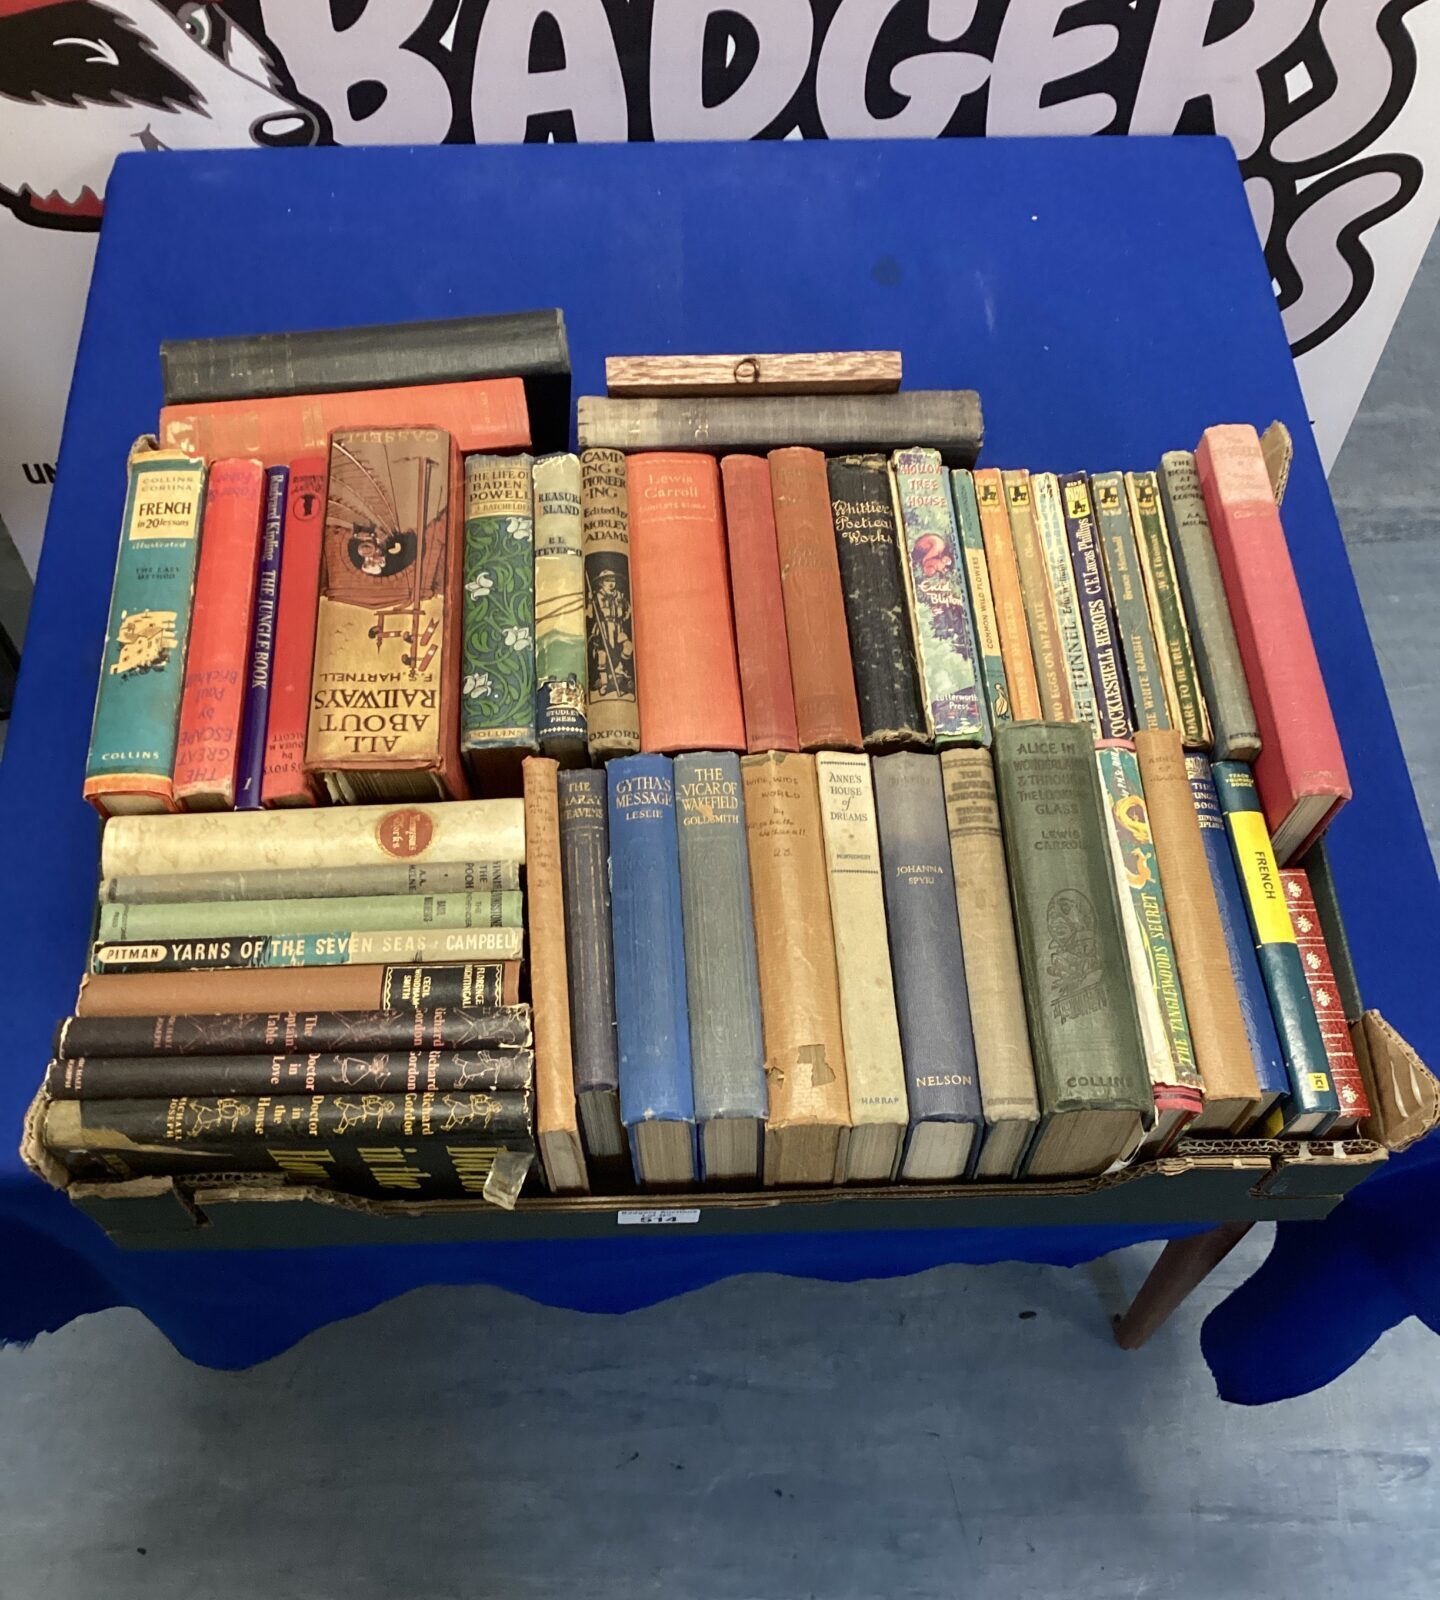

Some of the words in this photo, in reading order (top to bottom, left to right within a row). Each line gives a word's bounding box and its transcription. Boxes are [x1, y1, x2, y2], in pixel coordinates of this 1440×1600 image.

[262, 0, 1394, 163] BADGERS
[143, 476, 194, 484] COLLINS
[492, 471, 516, 479] LIFE
[649, 474, 693, 485] Lewis
[141, 484, 193, 492] CORTINA
[644, 486, 698, 499] Carroll
[908, 479, 938, 489] TREE
[267, 474, 285, 520] Rudyard
[906, 496, 947, 508] HOUSE
[139, 502, 191, 516] FRENCH
[584, 507, 615, 519] Edited
[145, 518, 160, 529] 20
[159, 519, 190, 527] lessons
[584, 519, 628, 533] MORLEY
[835, 516, 893, 531] Poetical
[262, 521, 281, 561] Kipling
[585, 532, 628, 544] ADAMS
[1076, 518, 1094, 552] Phillips
[132, 541, 187, 550] illustrated
[972, 557, 983, 590] FLOWERS
[262, 570, 277, 597] THE
[917, 581, 952, 592] Enid
[926, 593, 964, 608] Blyton
[979, 592, 987, 614] WILD
[255, 600, 274, 649] JUNGLE
[1034, 602, 1049, 632] PLATE
[1088, 599, 1111, 648] HEROES
[983, 614, 994, 649] COMMON
[1040, 633, 1052, 650] MY
[1043, 653, 1056, 670] ON
[1064, 621, 1088, 691] TUNNEL
[1131, 634, 1147, 672] RABBIT
[1170, 640, 1184, 666] FREE
[252, 651, 269, 690] BOOK
[320, 673, 401, 683] HARTNELL
[1176, 668, 1187, 682] BE
[1046, 671, 1060, 698] EGGS
[1098, 648, 1127, 738] COCKLESHELL
[1139, 675, 1154, 710] WHITE
[1179, 685, 1191, 698] TO
[315, 689, 436, 710] RAILWAYS
[949, 701, 970, 711] Press
[319, 714, 430, 732] ABOUT
[1182, 702, 1198, 734] DARE
[180, 728, 234, 746] ESCAPE
[589, 729, 640, 742] OXFORD
[344, 736, 402, 753] ALL
[1017, 742, 1057, 755] ALICE
[102, 751, 160, 761] COLLINS
[178, 747, 230, 766] GREAT
[186, 767, 217, 783] THE
[694, 768, 724, 782] THE
[829, 772, 862, 783] ANNE'S
[567, 782, 591, 792] THE
[616, 777, 671, 794] GYTHA'S
[681, 783, 721, 797] VICAR
[722, 782, 738, 796] OF
[831, 786, 862, 796] HOUSE
[681, 798, 738, 812] WAKEFIELD
[842, 797, 852, 811] of
[1035, 804, 1079, 816] GLASS
[626, 810, 663, 821] LESLIE
[683, 815, 739, 826] GOLDSMITH
[831, 812, 868, 822] DREAMS
[1042, 829, 1080, 840] LEWIS
[408, 864, 417, 891] MILNE
[465, 862, 475, 889] POOH
[479, 864, 488, 883] THE
[896, 864, 943, 877] JOHANNA
[1255, 851, 1276, 900] FRENCH
[1141, 892, 1164, 940] SECRET
[106, 949, 159, 960] PITMAN
[171, 942, 231, 961] YARNS
[240, 941, 264, 958] OF
[271, 939, 306, 957] THE
[316, 937, 373, 955] SEVEN
[383, 936, 427, 952] SEAS
[402, 975, 411, 999] SMITH
[421, 976, 431, 998] CECIL
[475, 966, 486, 1006] FLORENCE
[265, 1014, 280, 1044] Table
[304, 1014, 318, 1037] The
[1174, 1035, 1191, 1066] THE
[271, 1056, 285, 1084] Love
[289, 1063, 302, 1076] in
[306, 1053, 321, 1091] Doctor
[916, 1074, 972, 1087] NELSON
[861, 1096, 900, 1105] HARRAP
[166, 1098, 175, 1138] JOSEPH
[254, 1096, 271, 1135] House
[273, 1104, 286, 1125] the
[292, 1107, 304, 1120] in
[309, 1095, 325, 1136] Doctor
[404, 1092, 418, 1135] Gordon
[421, 1091, 435, 1135] Richard
